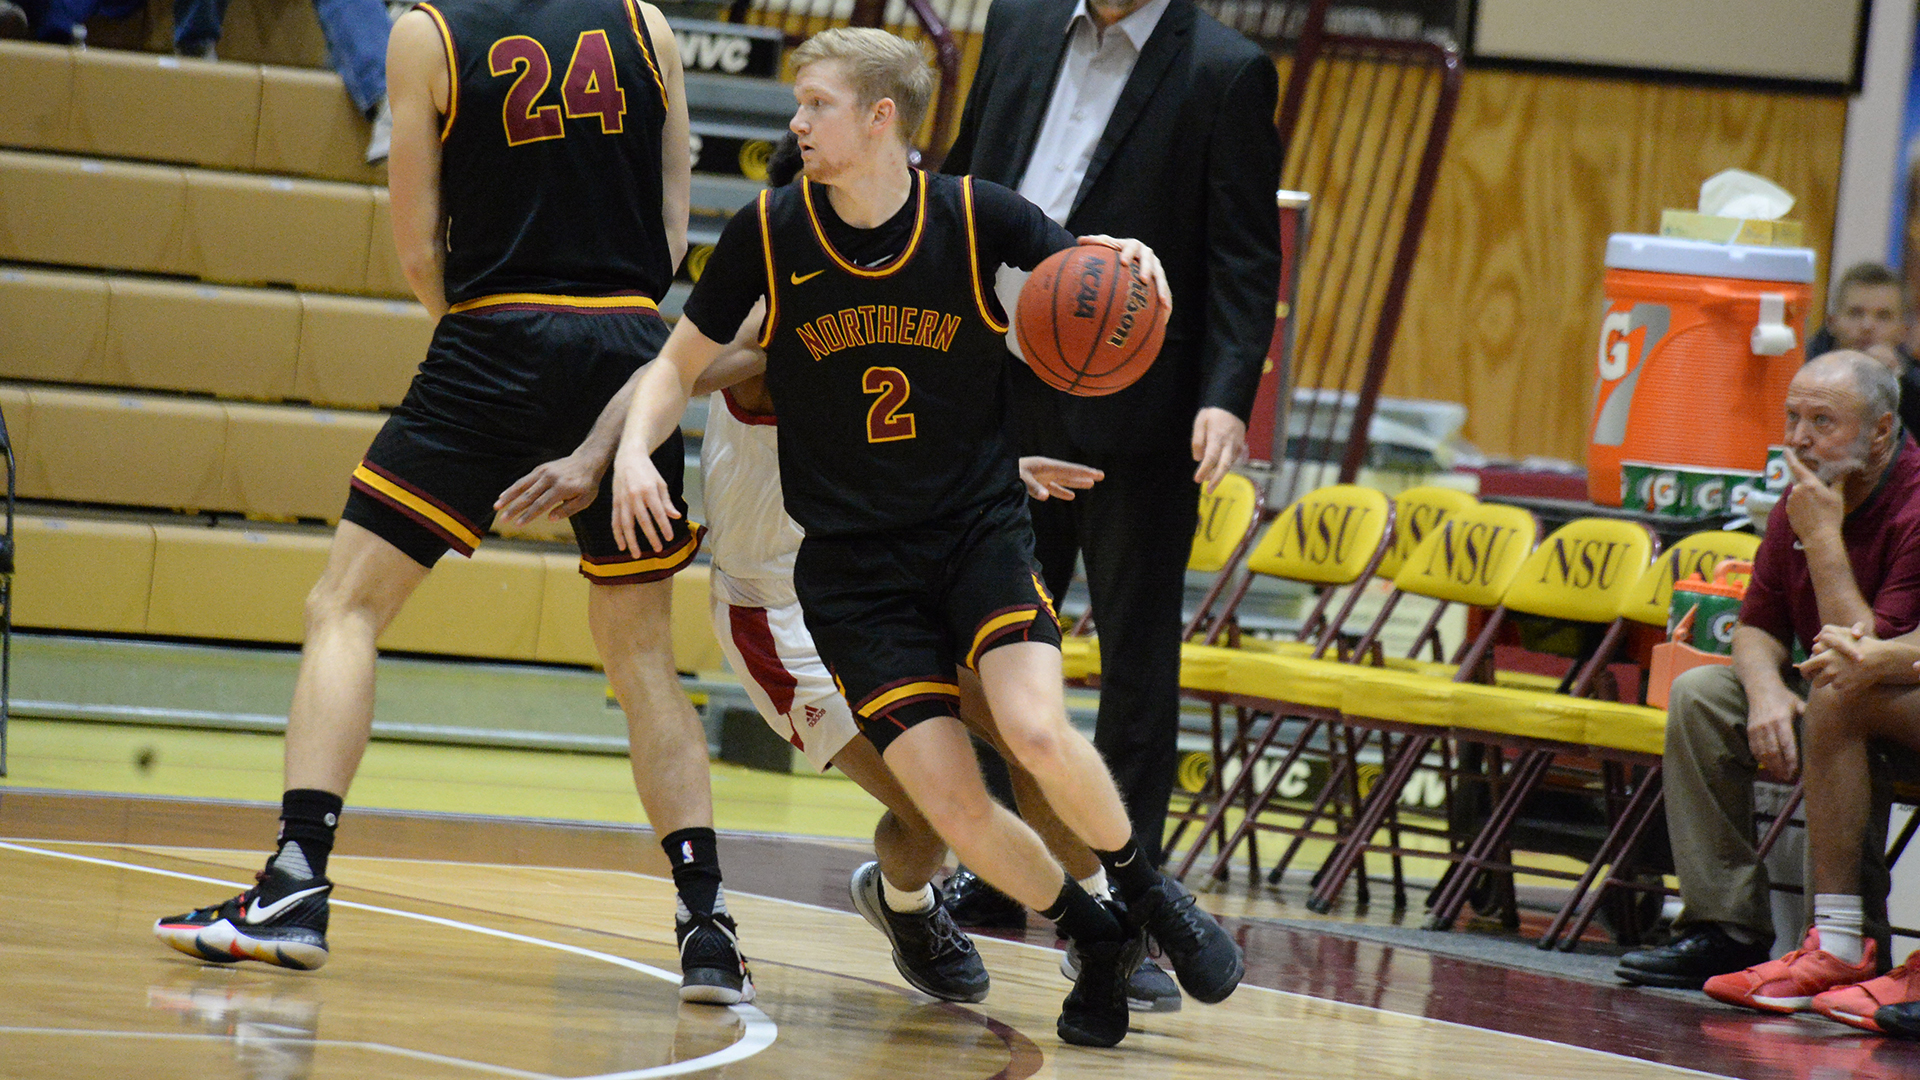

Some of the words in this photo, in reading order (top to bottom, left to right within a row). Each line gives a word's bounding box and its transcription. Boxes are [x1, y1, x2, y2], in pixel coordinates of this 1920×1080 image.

[488, 29, 626, 147] 24
[1074, 255, 1106, 319] NCAA
[795, 304, 962, 362] NORTHERN
[1598, 312, 1630, 382] G
[862, 365, 917, 443] 2
[1653, 476, 1677, 508] G
[1697, 480, 1725, 511] G
[1275, 502, 1371, 565] NSU
[1422, 520, 1518, 587] NSU
[1538, 538, 1632, 590] NSU
[1647, 548, 1750, 606] NS
